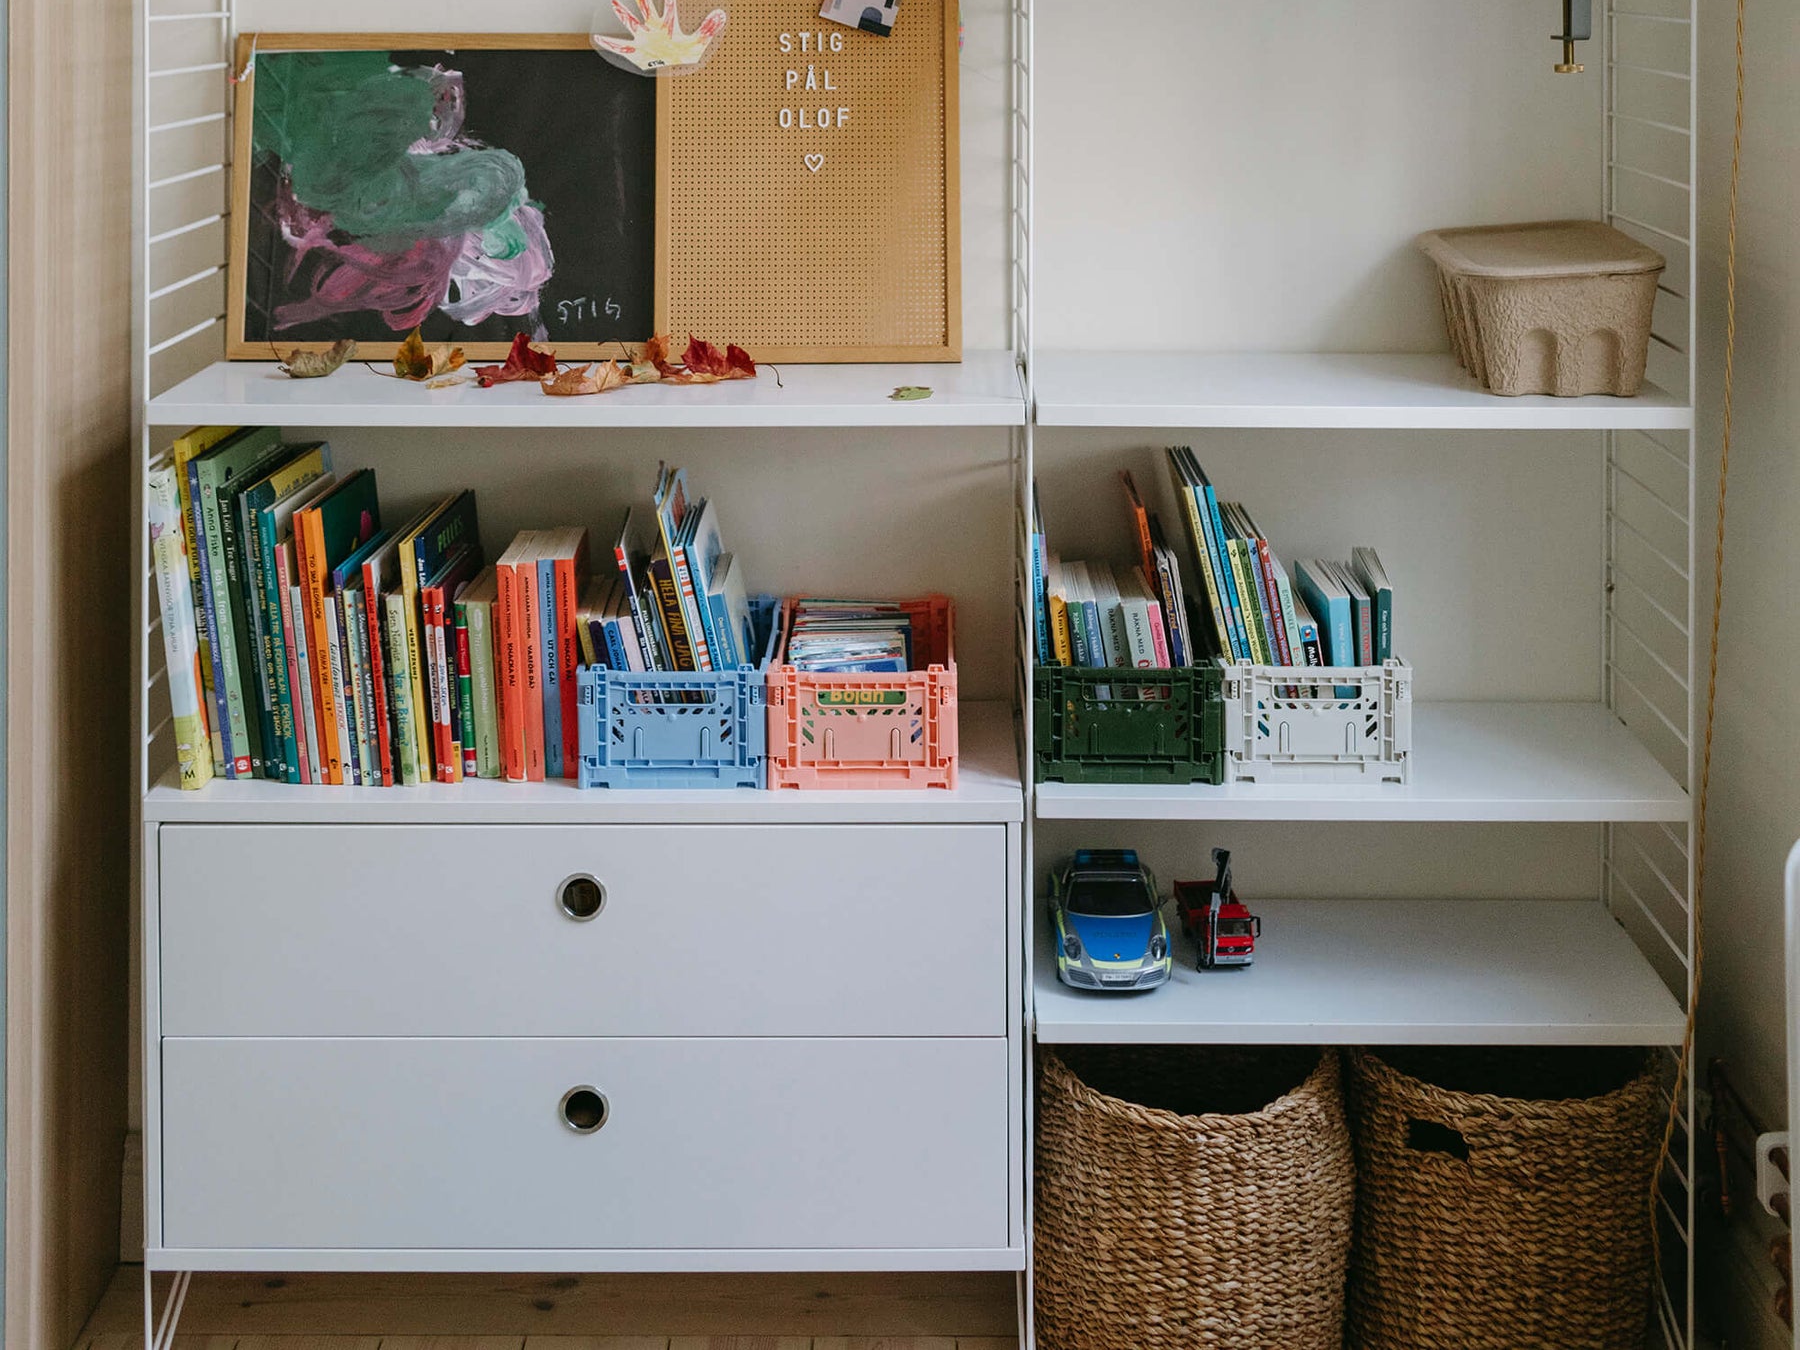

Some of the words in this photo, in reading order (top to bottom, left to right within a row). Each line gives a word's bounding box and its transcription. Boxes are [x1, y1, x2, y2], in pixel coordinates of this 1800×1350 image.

[779, 32, 843, 53] STIG
[785, 64, 837, 91] PÅL
[779, 107, 850, 129] OLOF
[557, 297, 621, 324] STIG
[219, 498, 230, 513] Jan
[205, 507, 217, 532] Anna
[221, 514, 232, 534] Lööf
[184, 507, 194, 523] VAD
[189, 546, 199, 567] FOLK
[208, 534, 220, 556] Fiske
[225, 546, 236, 560] Tre
[308, 554, 317, 568] TIO
[416, 557, 424, 572] Jan
[213, 568, 224, 587] Bak
[658, 577, 676, 607] HELA
[217, 600, 228, 624] fram
[269, 601, 278, 620] ALLA
[388, 609, 399, 628] Sven
[641, 610, 649, 622] PIJA
[1106, 607, 1118, 634] RÄKNA
[666, 610, 684, 637] FINA
[1131, 612, 1142, 637] RÄKNA
[546, 639, 554, 650] UT
[607, 629, 617, 647] CARL
[705, 625, 716, 647] VEMS
[1111, 634, 1120, 651] MED
[1136, 637, 1145, 654] MED
[506, 642, 514, 673] KNACKA
[546, 652, 555, 669] OCH
[563, 638, 571, 667] KNACKA
[611, 648, 623, 672] JOHAN
[673, 638, 693, 668] JAG
[1306, 645, 1317, 667] Molly
[393, 669, 406, 690] Var
[829, 691, 885, 705] Bojan
